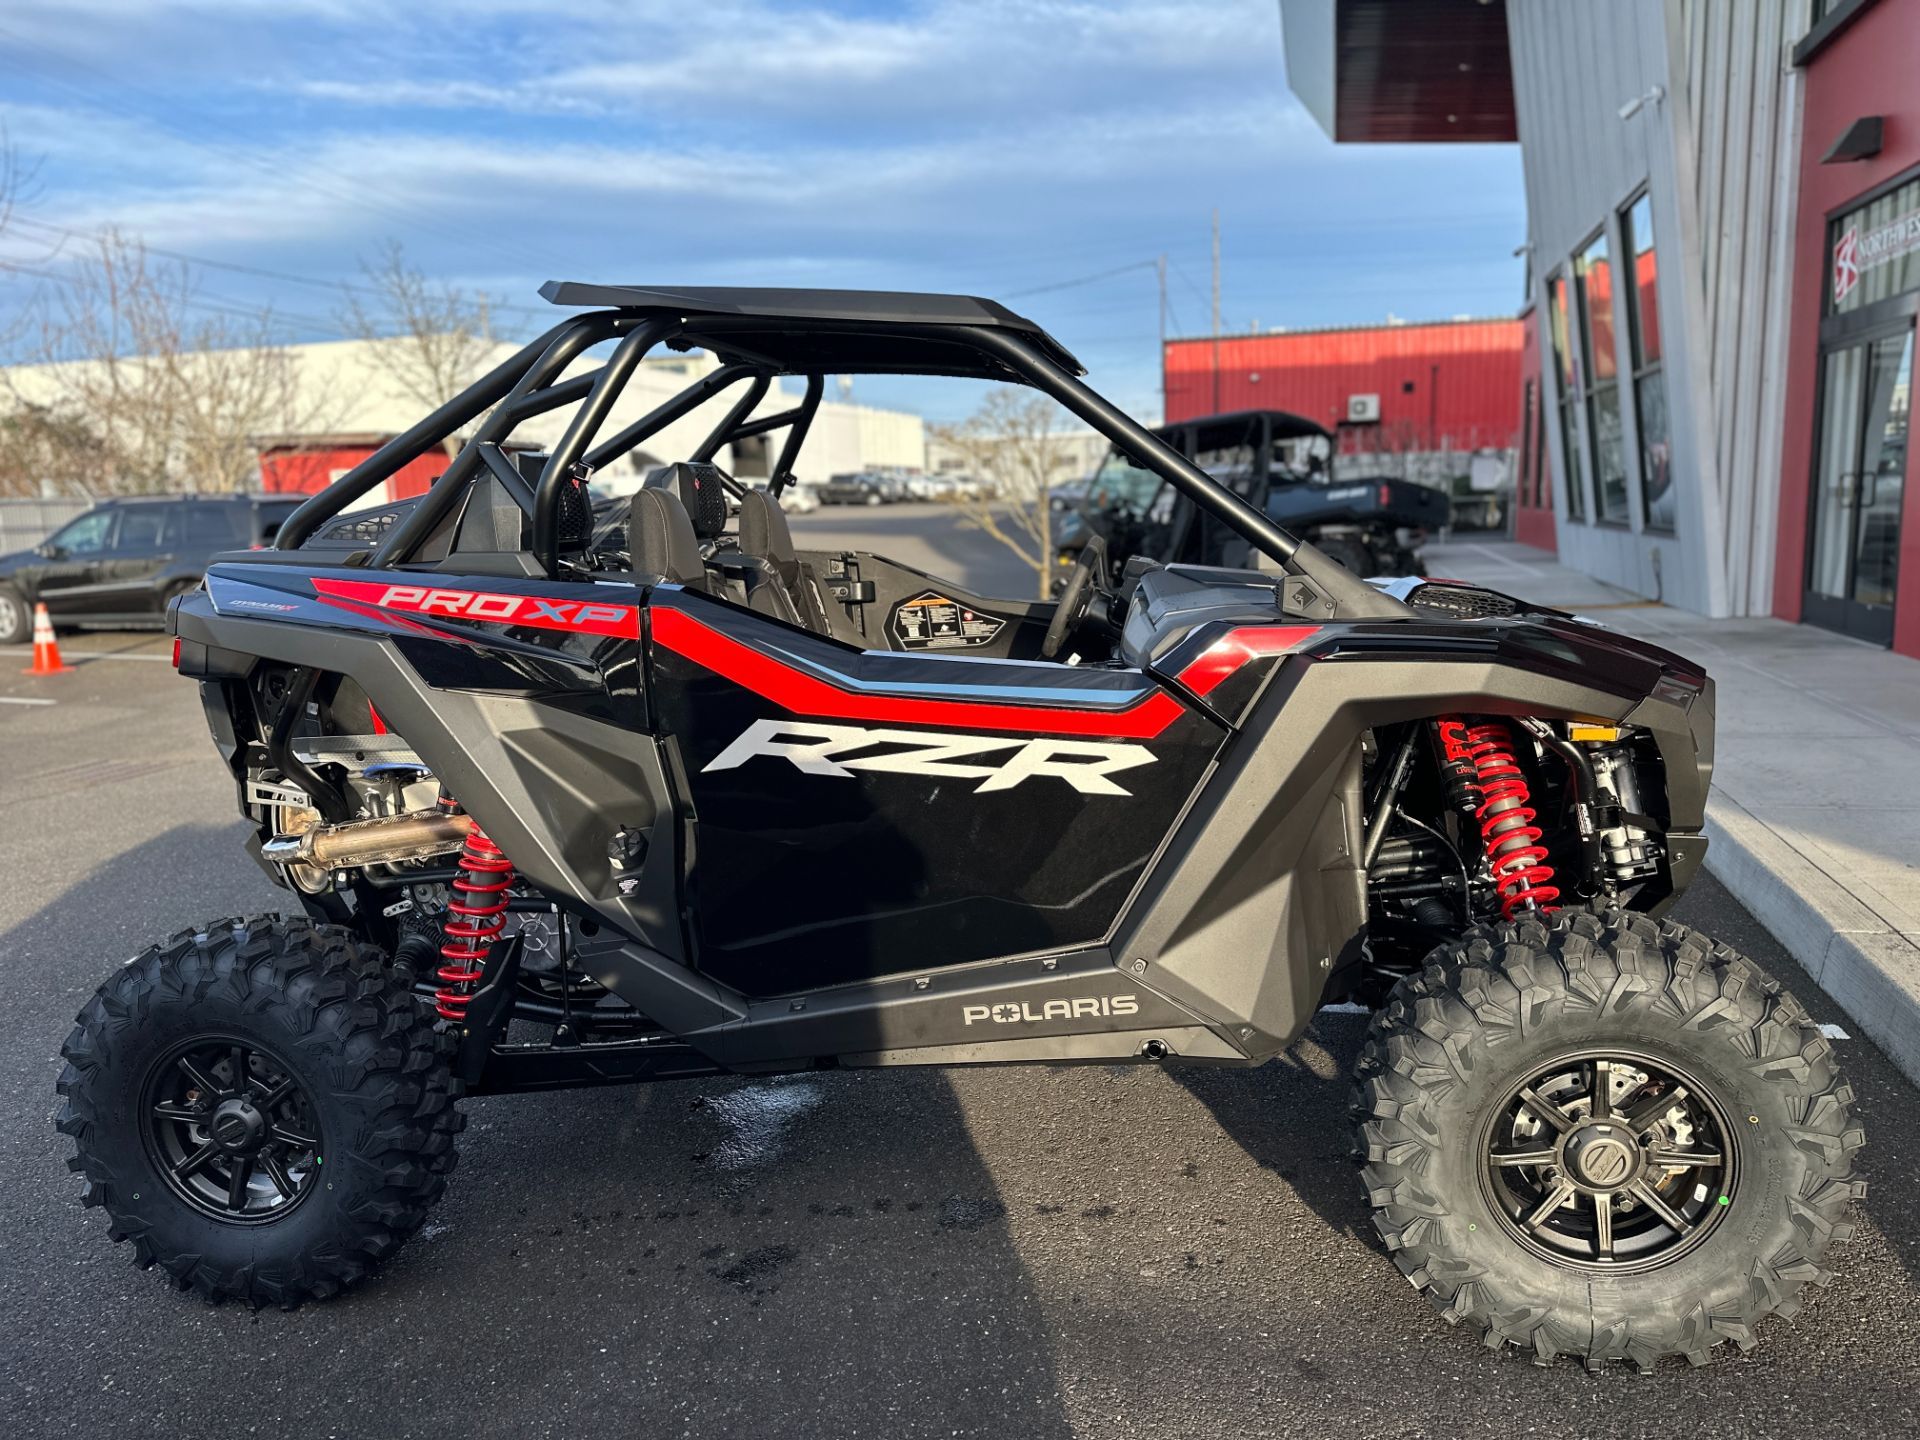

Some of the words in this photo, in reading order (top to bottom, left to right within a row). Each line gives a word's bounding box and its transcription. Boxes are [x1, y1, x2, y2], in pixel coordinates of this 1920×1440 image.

[377, 586, 524, 618] PRO
[523, 601, 629, 624] XP
[700, 718, 1159, 796] RZR
[962, 993, 1139, 1026] POLARIS
